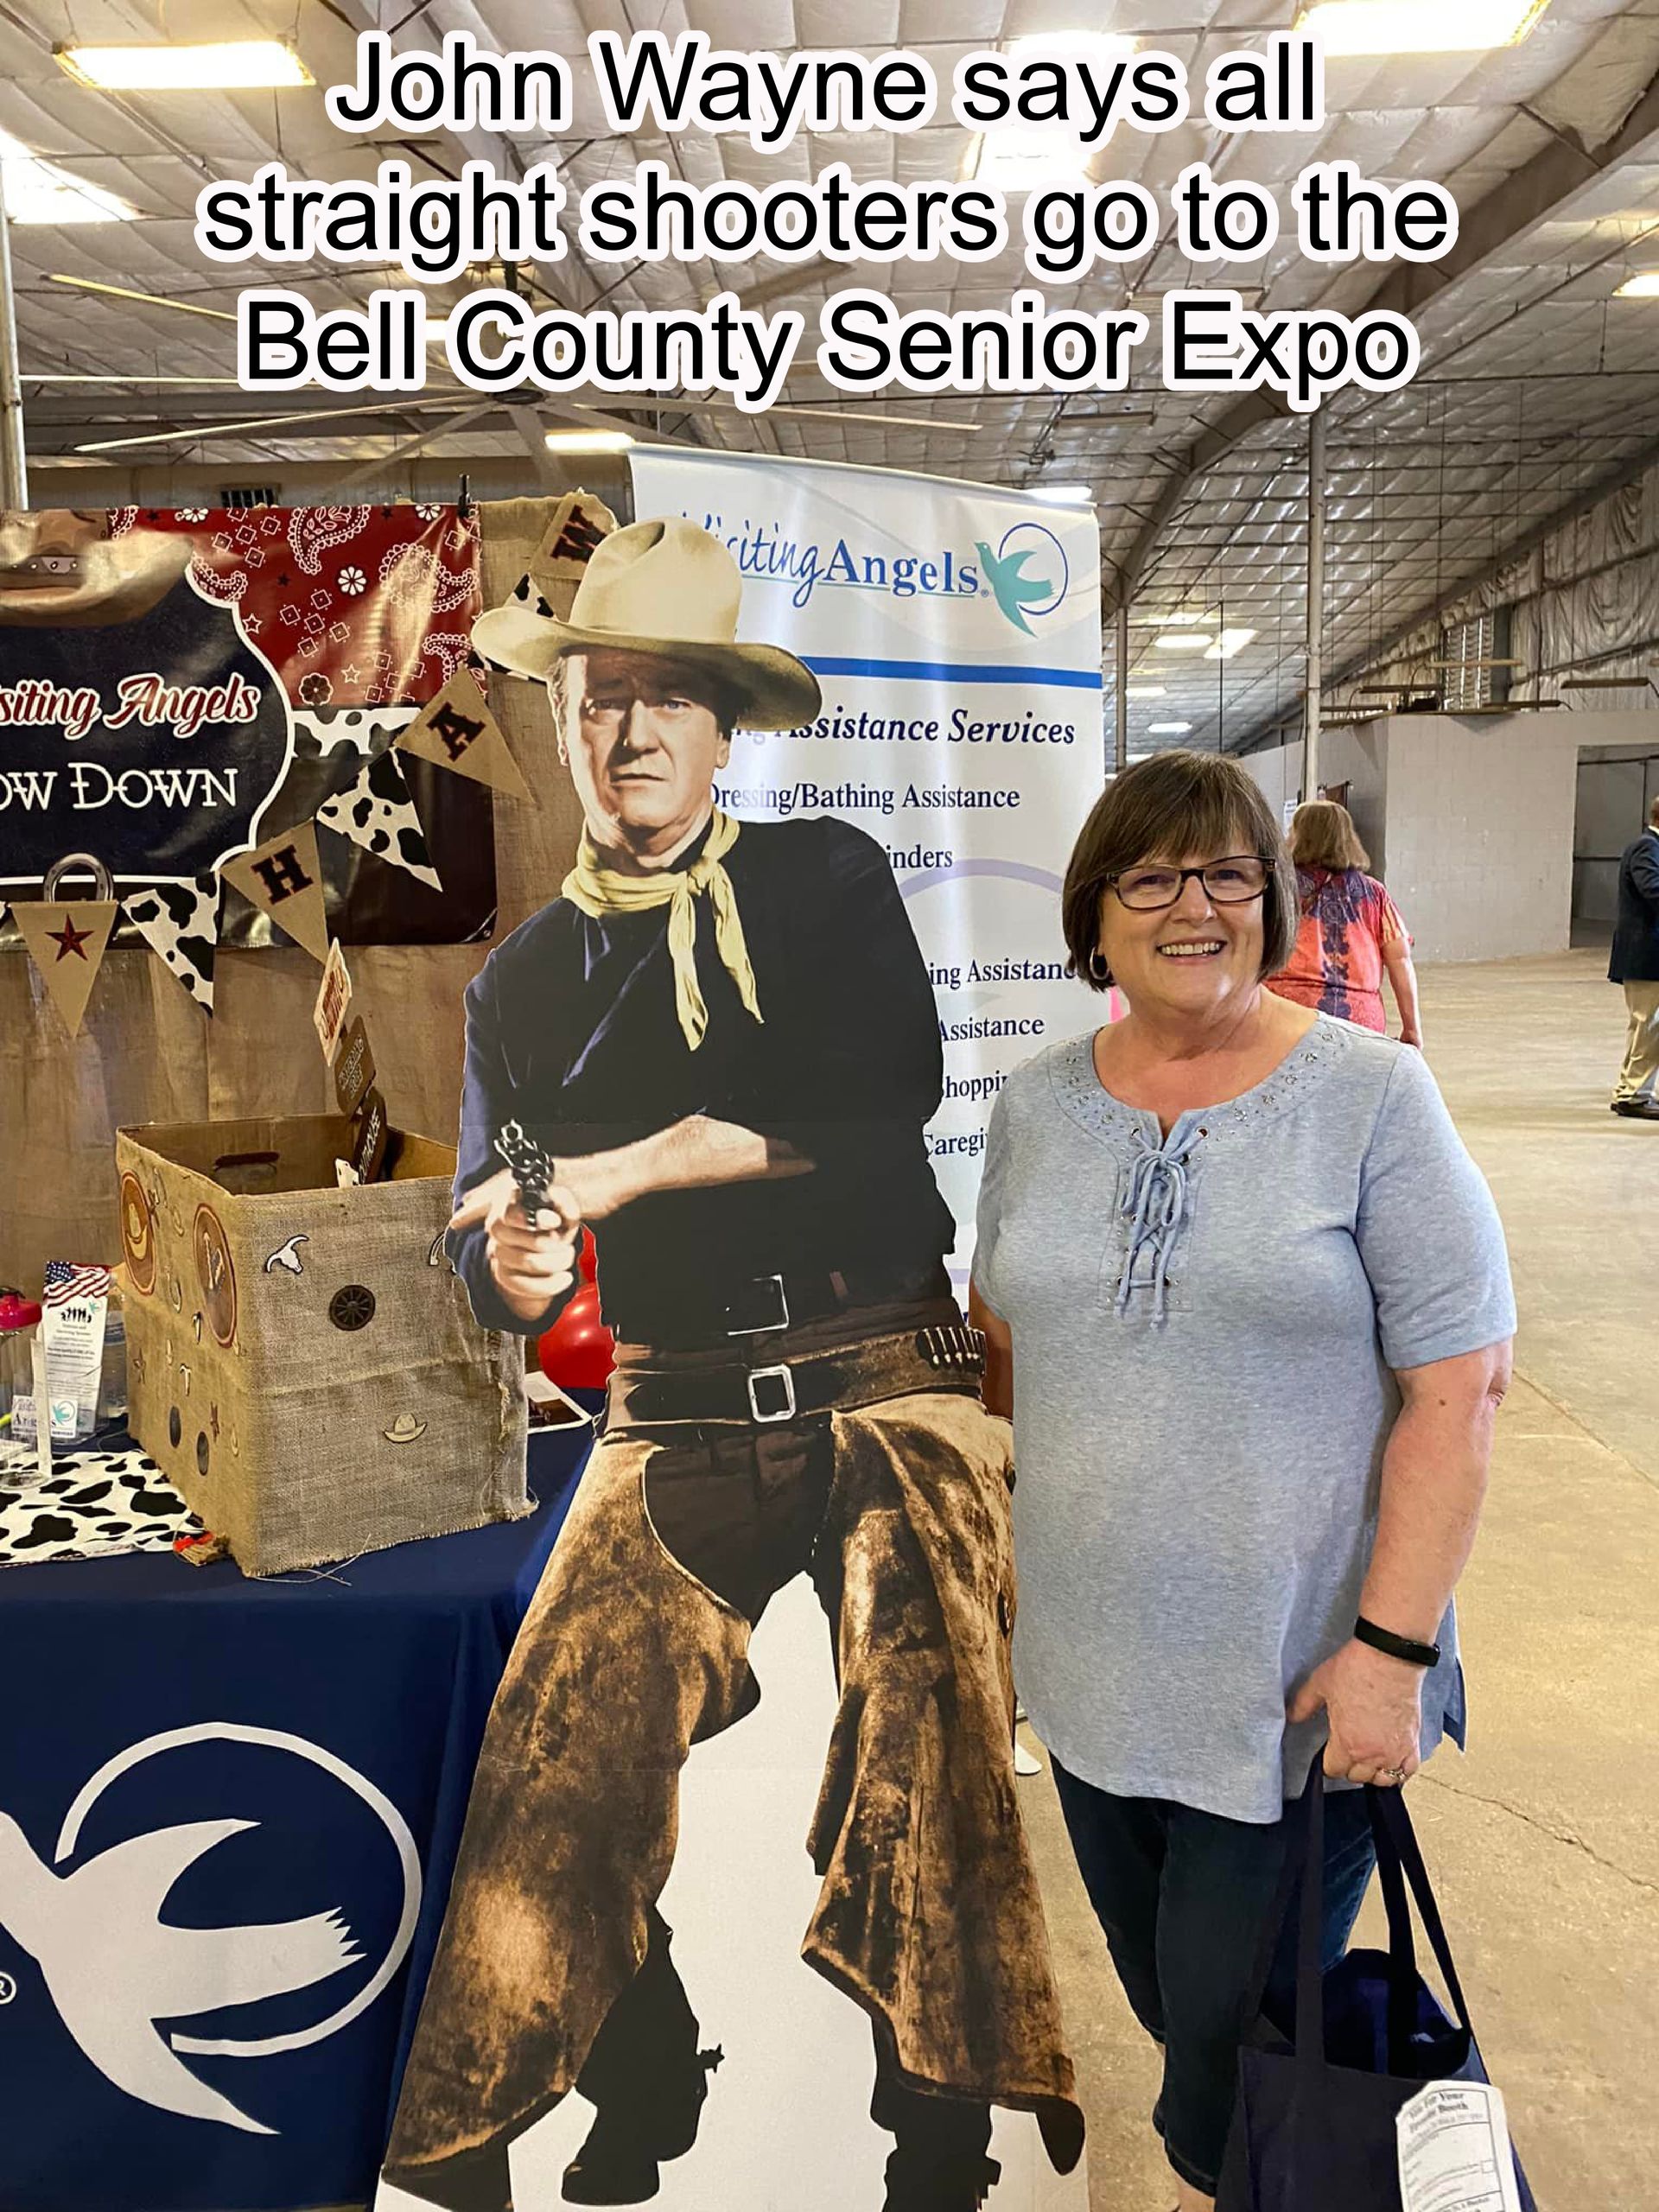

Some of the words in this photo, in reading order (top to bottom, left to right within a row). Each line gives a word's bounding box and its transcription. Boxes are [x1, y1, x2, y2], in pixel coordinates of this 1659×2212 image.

[683, 512, 824, 607] iting
[823, 538, 979, 597] Angels
[103, 673, 260, 738] Angels
[947, 709, 1076, 744] Services
[67, 761, 238, 809] DOWN
[902, 784, 1020, 809] Assistance
[967, 957, 1077, 982] Assistanc
[924, 1127, 988, 1157] aregi
